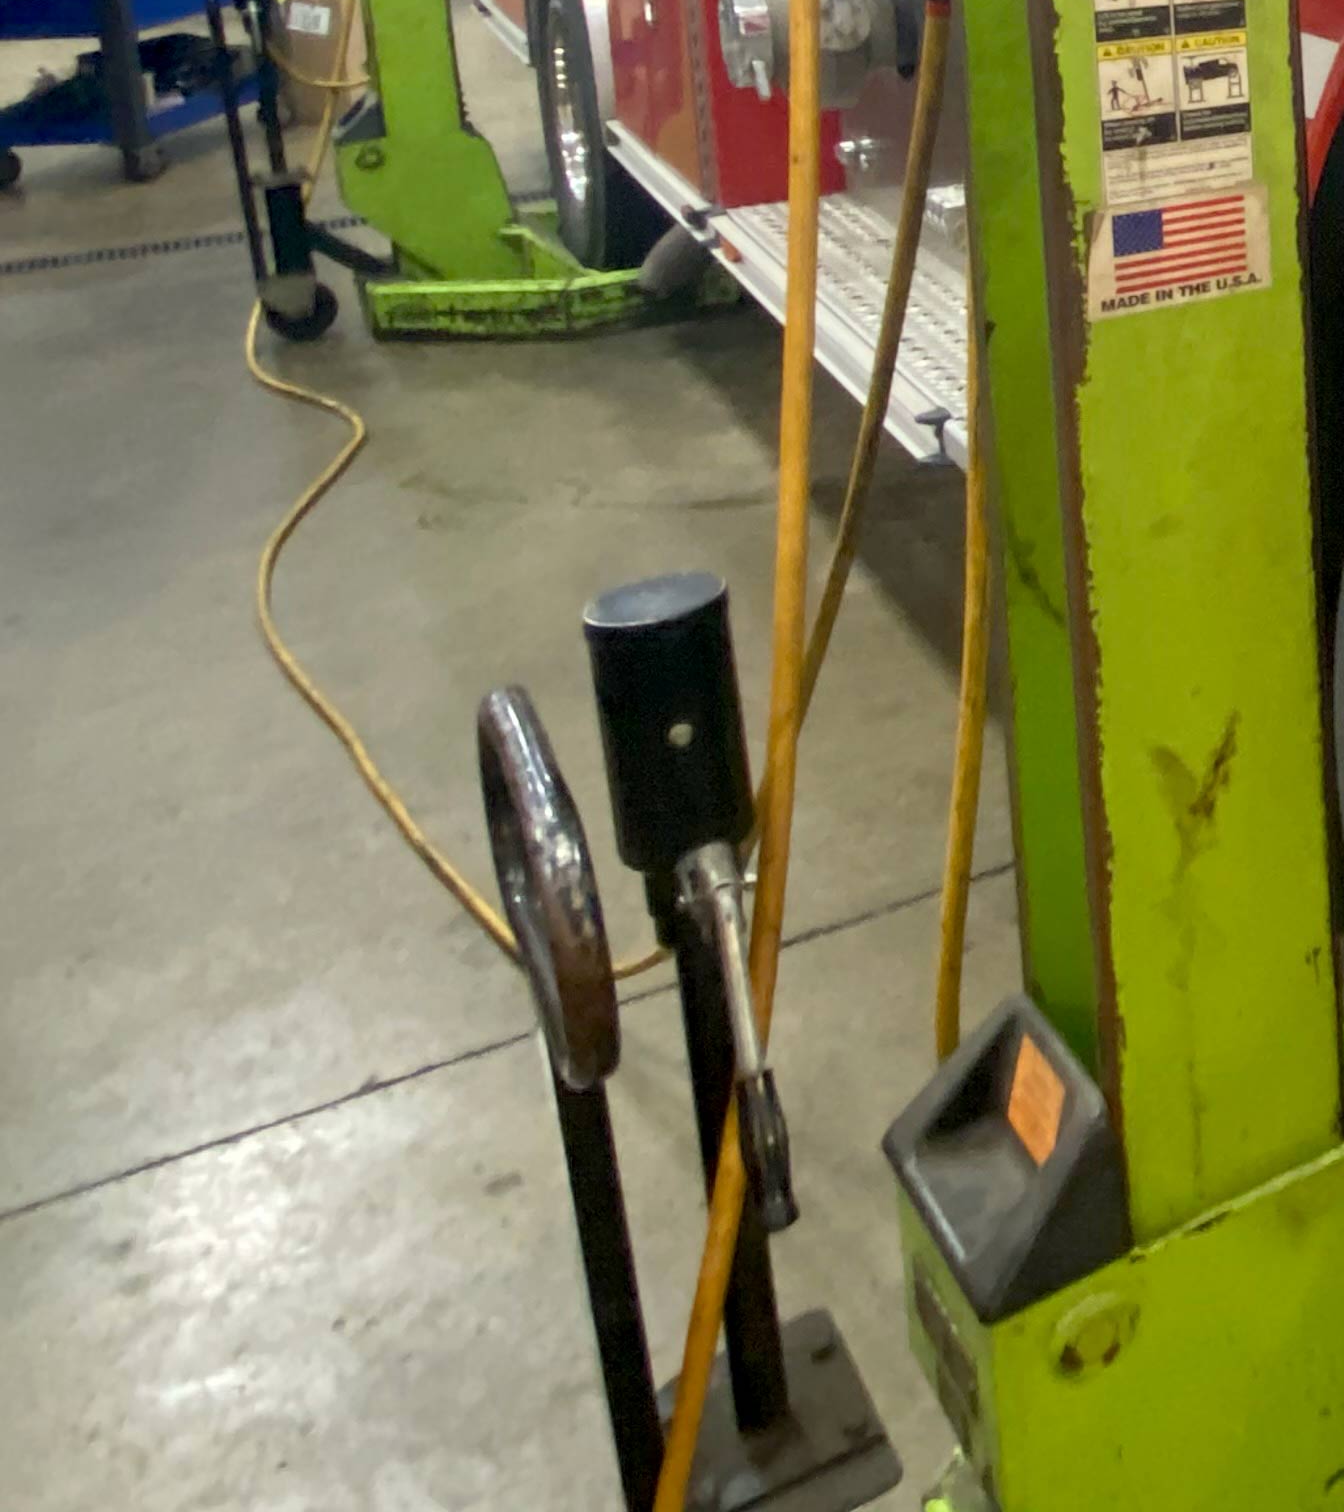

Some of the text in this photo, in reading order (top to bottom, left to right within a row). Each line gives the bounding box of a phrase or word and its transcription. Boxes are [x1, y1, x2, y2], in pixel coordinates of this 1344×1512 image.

[1194, 35, 1240, 46] CAUTION
[1101, 272, 1262, 313] MADE IN THE U.S.A.
